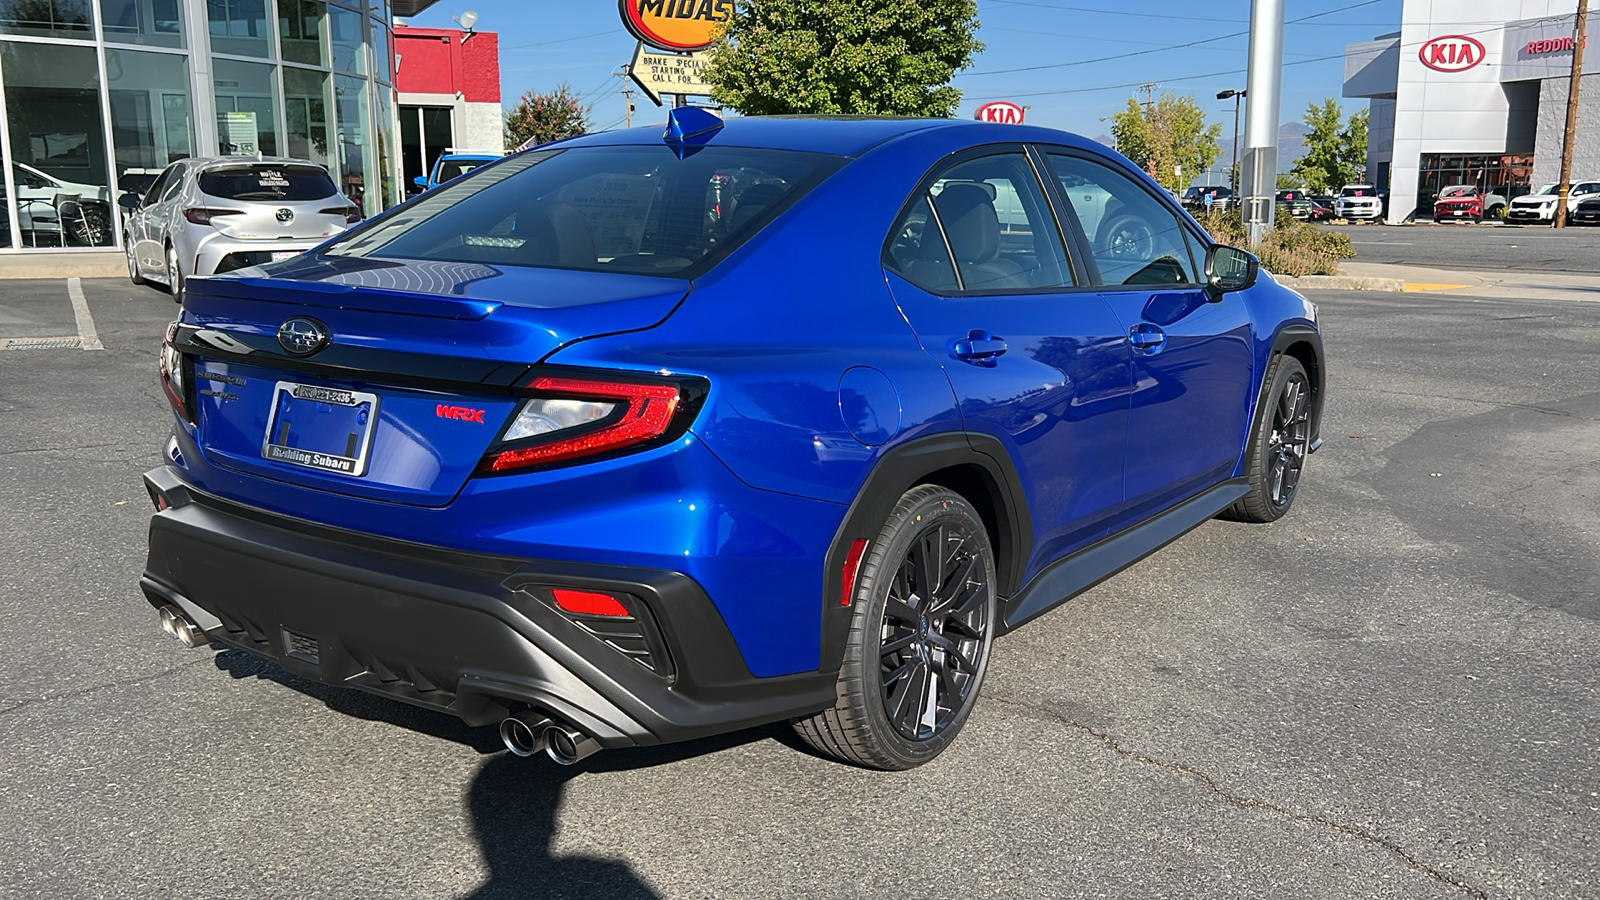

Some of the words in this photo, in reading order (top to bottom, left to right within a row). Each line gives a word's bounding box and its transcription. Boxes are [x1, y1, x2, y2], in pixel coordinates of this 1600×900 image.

[637, 0, 730, 22] MIDAS
[1430, 43, 1474, 65] KIA
[1526, 35, 1586, 54] REDDIN
[643, 57, 667, 67] BRAKE
[651, 66, 685, 75] STARTING
[652, 74, 672, 82] CALL
[677, 75, 691, 84] FOR
[986, 107, 1016, 124] KIA
[436, 404, 485, 424] WRX
[273, 446, 311, 464] Redding
[312, 455, 350, 470] Subaru
